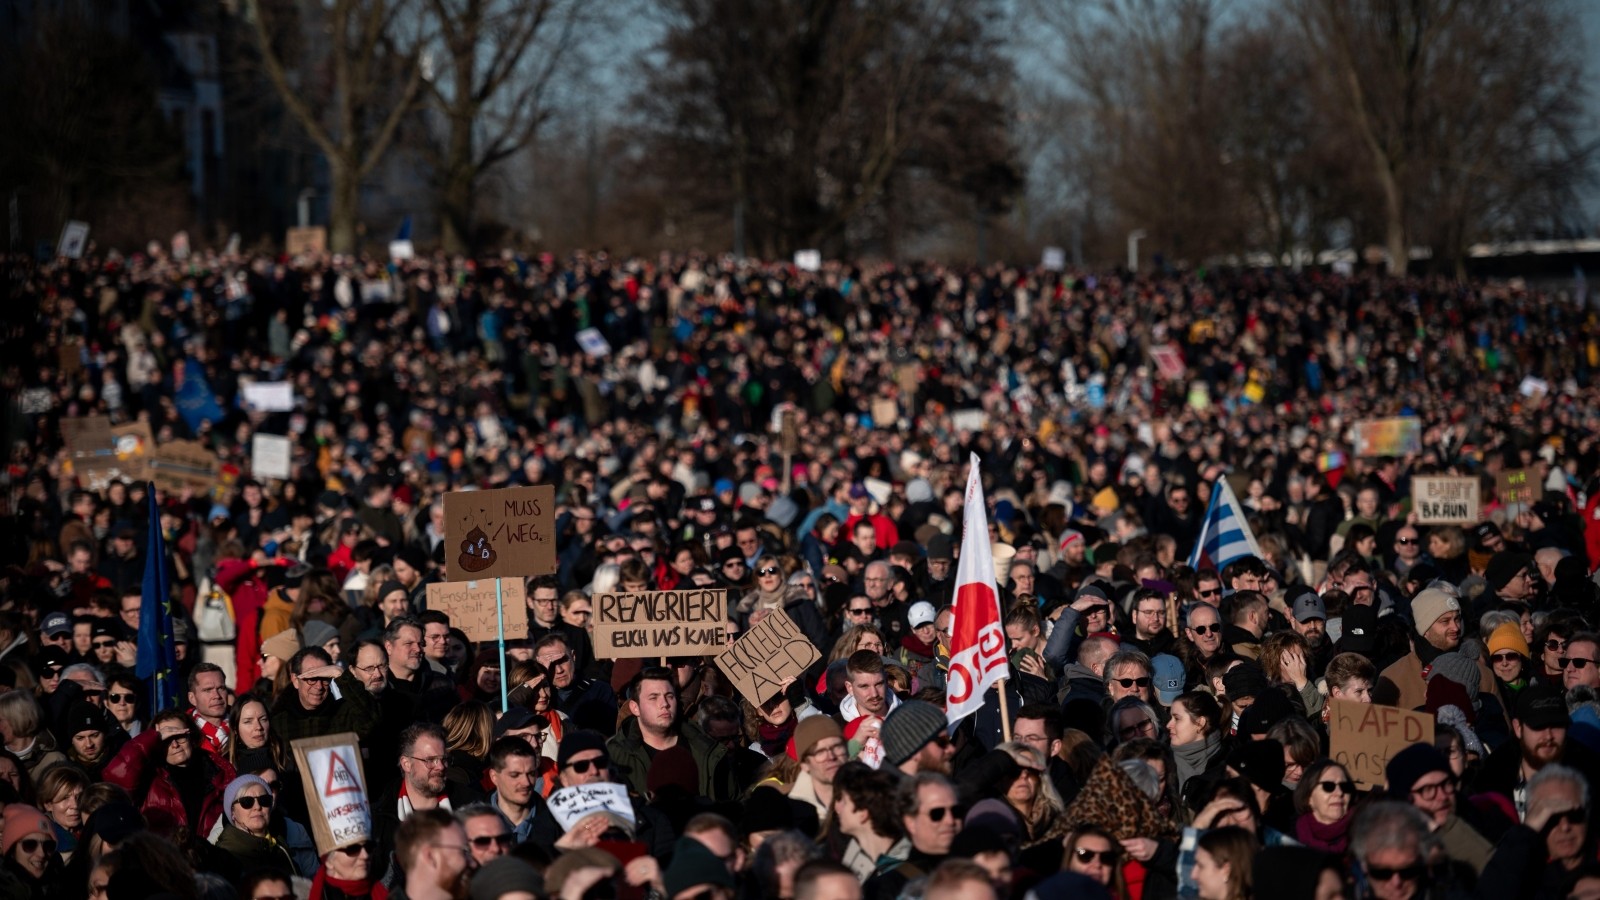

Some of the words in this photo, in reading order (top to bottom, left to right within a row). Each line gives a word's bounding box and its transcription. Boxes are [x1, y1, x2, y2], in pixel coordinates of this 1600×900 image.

[505, 499, 541, 517] MUSS
[1423, 502, 1467, 518] BRAUN
[507, 522, 543, 544] WEG.
[430, 582, 518, 604] Menschenrehte
[600, 589, 727, 622] REMIGRIERT
[478, 616, 525, 633] Menchen
[751, 609, 798, 655] EUCH
[612, 629, 648, 647] EUCH
[653, 626, 681, 647] INS
[685, 627, 725, 646] KNIE
[752, 640, 814, 704] AFD
[1335, 744, 1389, 776] anst
